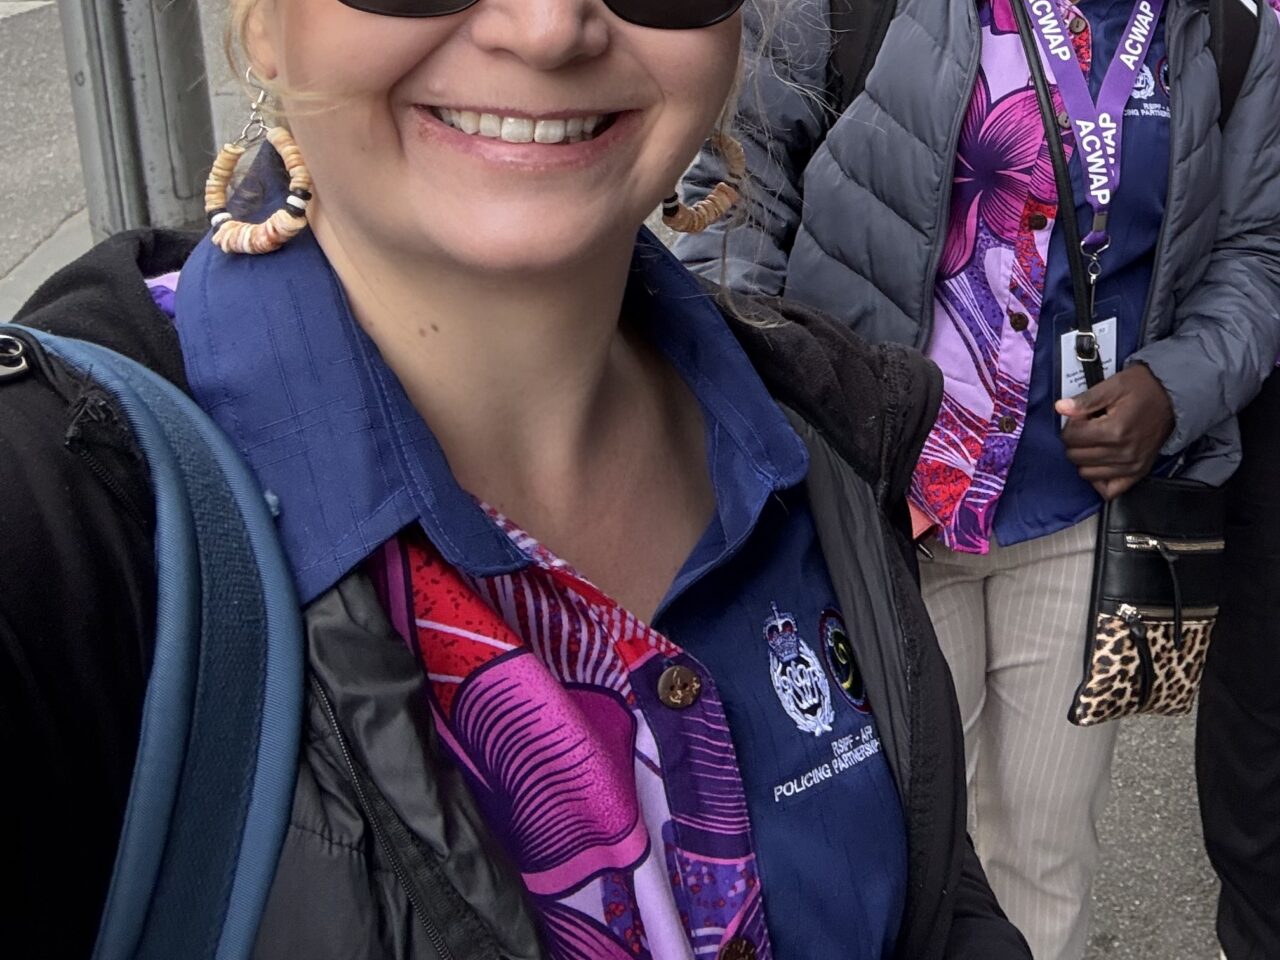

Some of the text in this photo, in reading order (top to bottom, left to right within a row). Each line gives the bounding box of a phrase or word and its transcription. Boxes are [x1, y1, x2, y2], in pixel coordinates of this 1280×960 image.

[1119, 0, 1155, 71] ACWAP
[1075, 119, 1111, 206] ACWAP
[774, 763, 833, 803] POLICING
